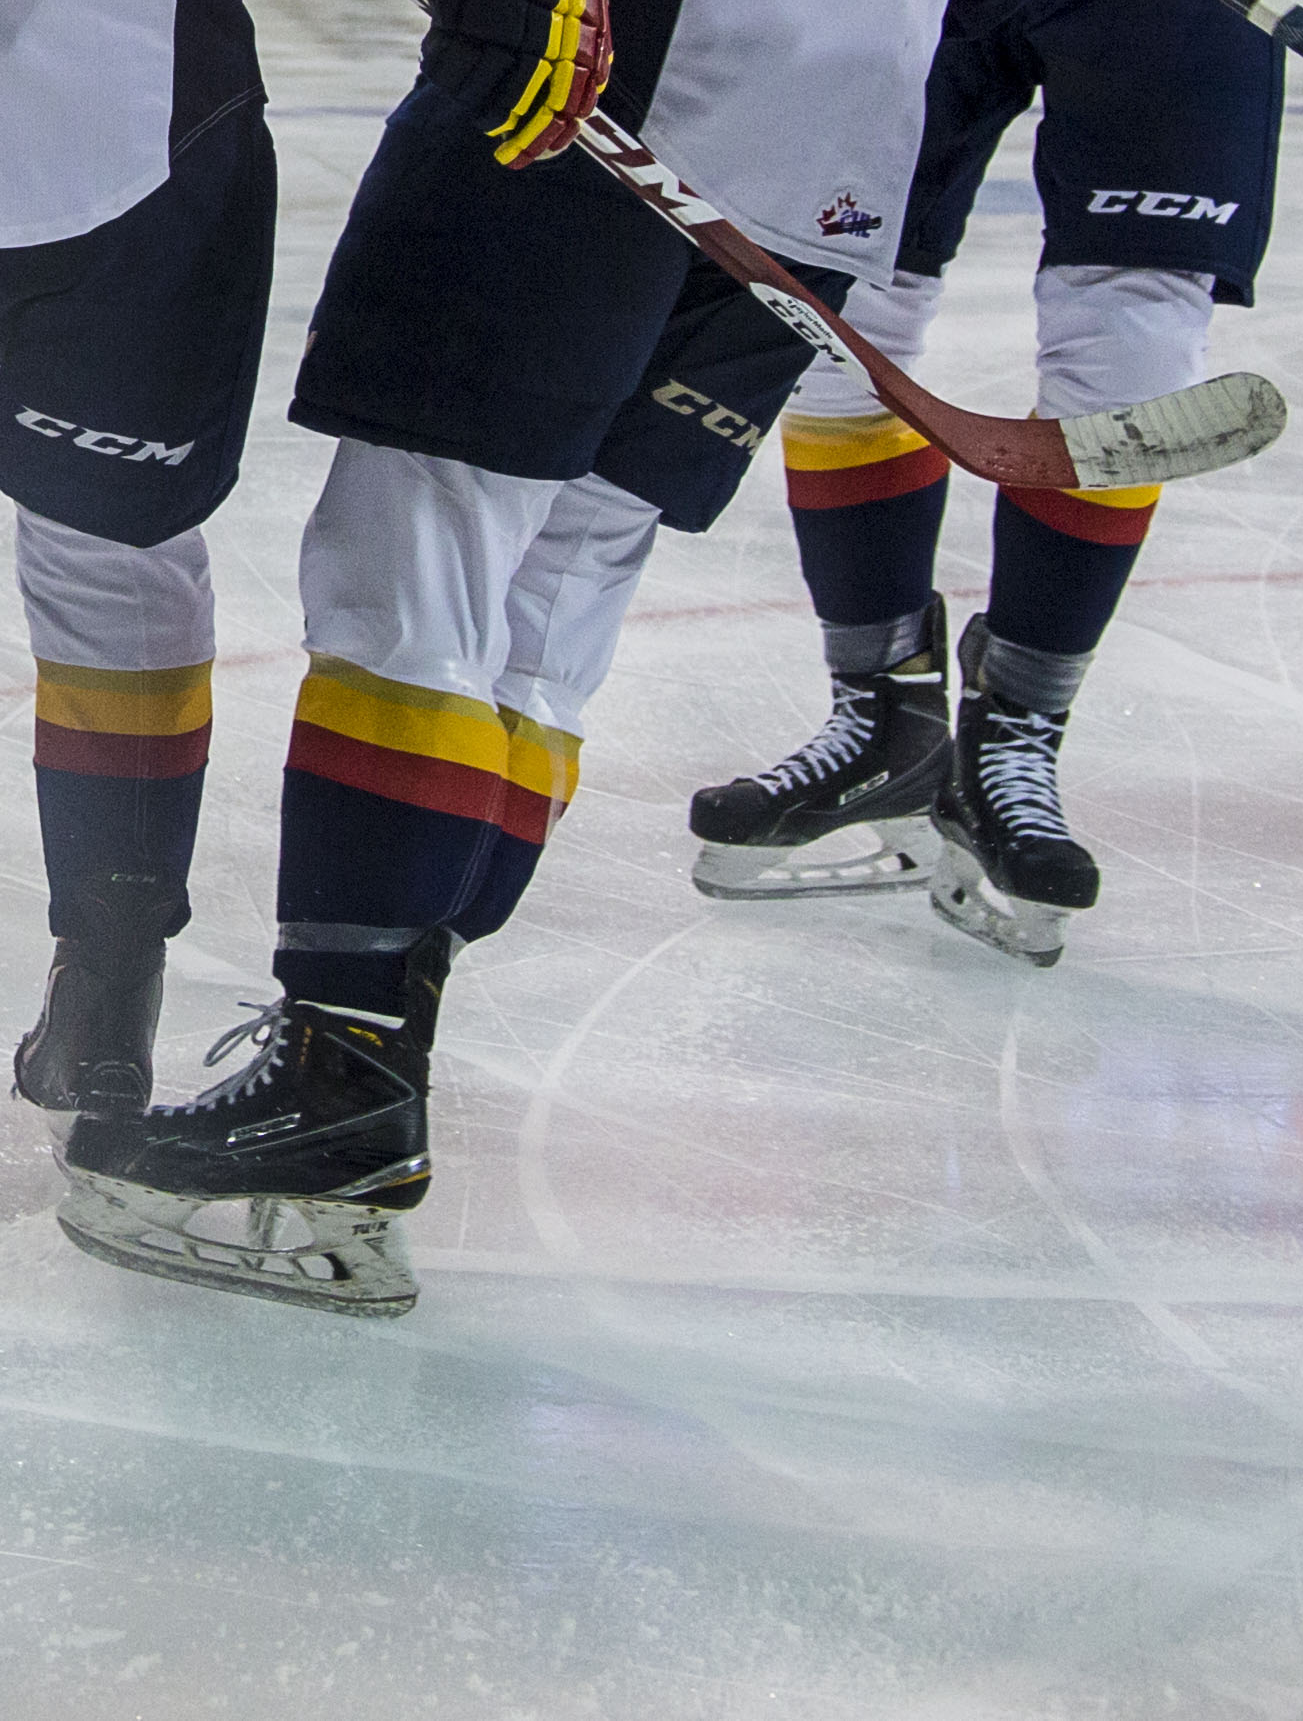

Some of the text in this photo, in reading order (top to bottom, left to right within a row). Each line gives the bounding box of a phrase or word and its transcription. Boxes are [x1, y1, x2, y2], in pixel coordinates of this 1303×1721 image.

[1085, 189, 1240, 226] CCM
[766, 298, 847, 363] CCM
[14, 404, 196, 466] CCM
